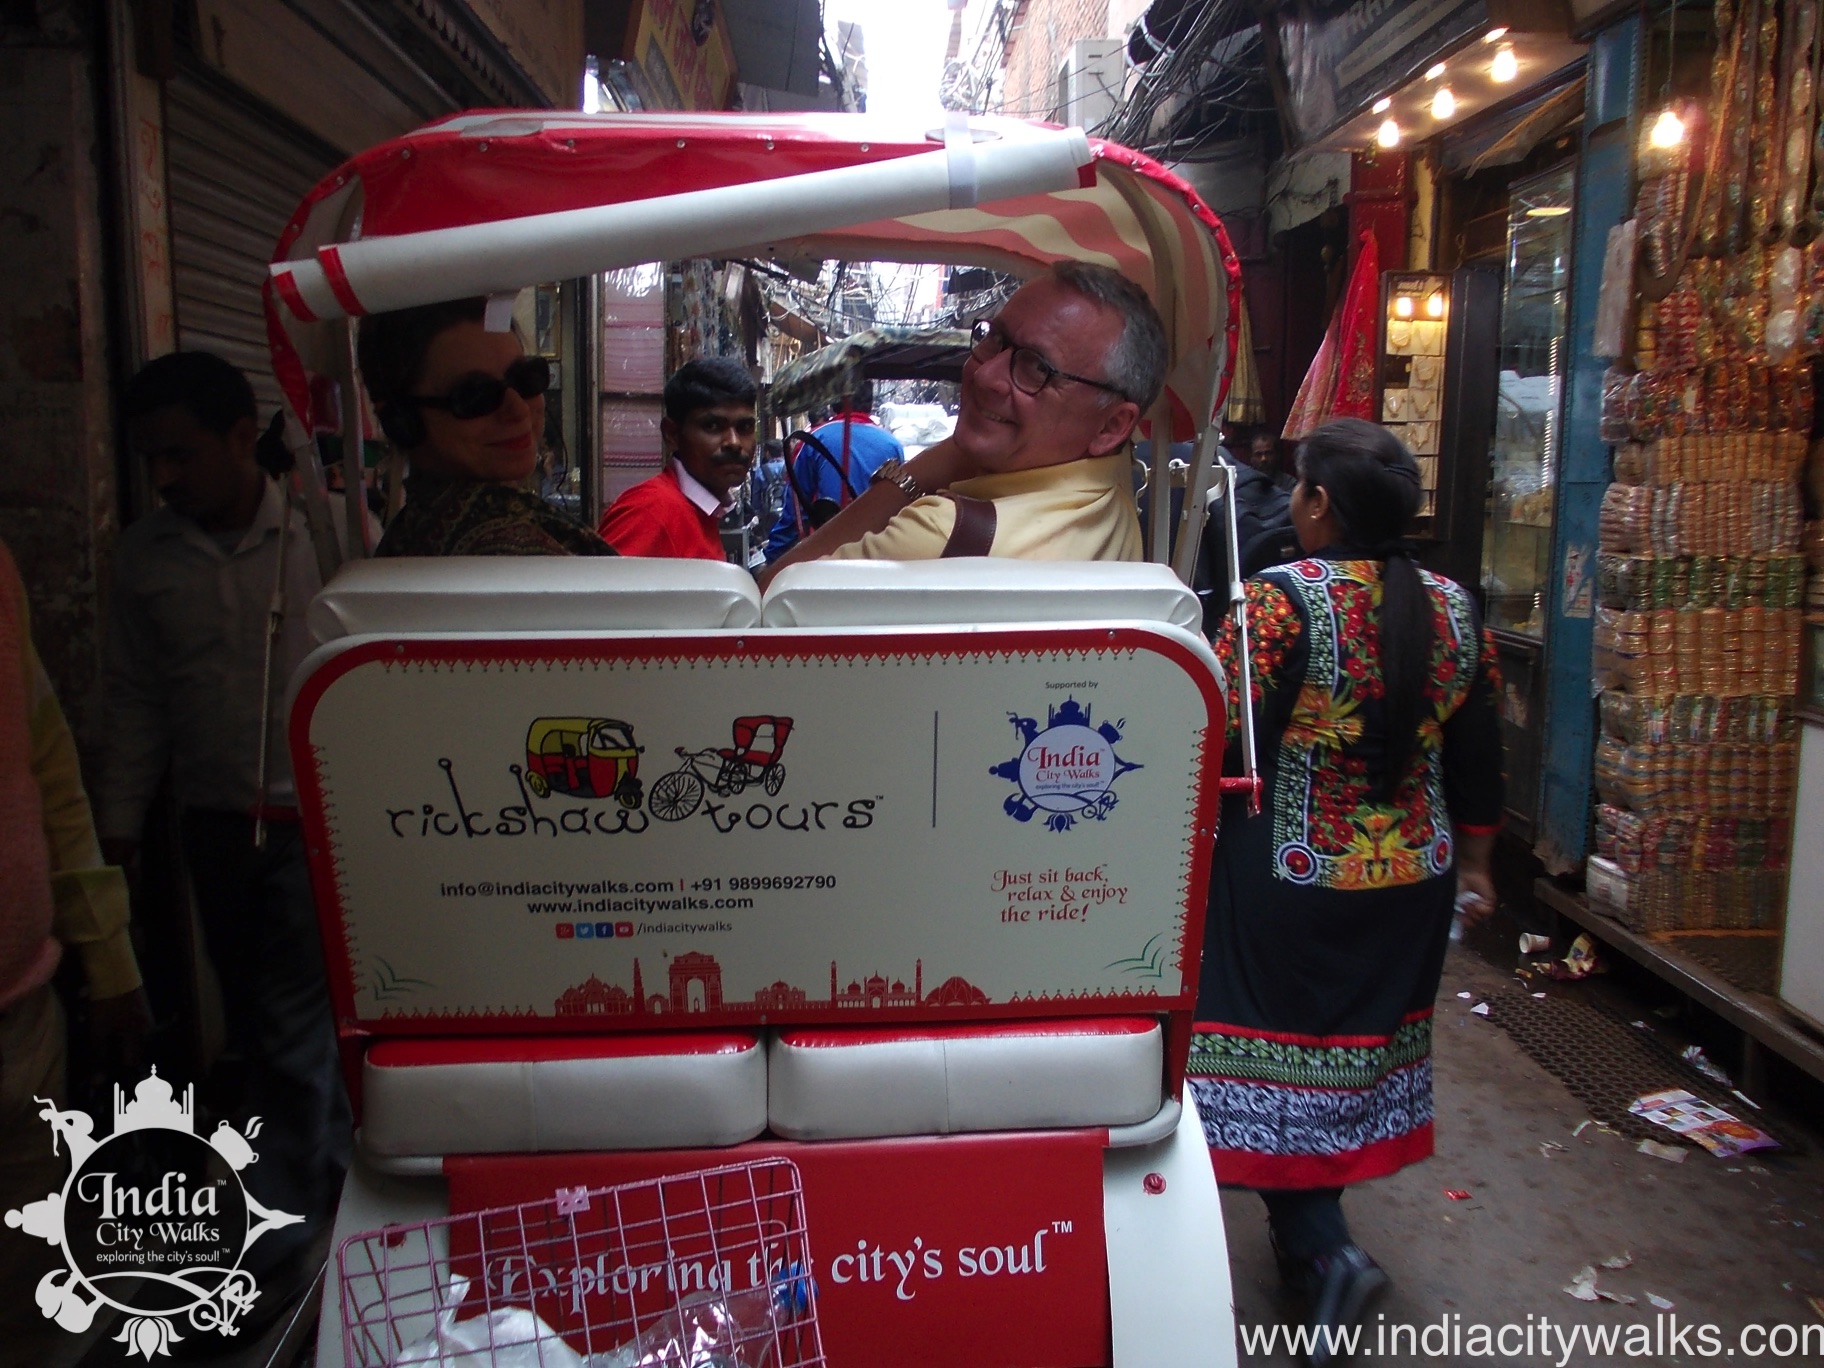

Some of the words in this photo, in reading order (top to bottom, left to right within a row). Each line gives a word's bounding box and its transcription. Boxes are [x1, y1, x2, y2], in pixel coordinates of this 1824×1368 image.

[1045, 681, 1087, 690] Supported
[1088, 680, 1099, 689] by
[1027, 745, 1100, 769] India
[1036, 769, 1061, 783] City
[1063, 769, 1100, 780] Walks
[385, 757, 650, 838] rickshaw
[701, 797, 876, 834] tours
[440, 879, 674, 898] info@indiacitywalks.com
[690, 877, 721, 892] +91
[728, 875, 837, 891] 9899692790
[990, 869, 1033, 892] Just
[1038, 868, 1059, 884] sit
[1064, 867, 1109, 883] back,
[1007, 887, 1053, 903] relax
[1060, 885, 1076, 903] &
[1081, 884, 1129, 905] enjoy
[526, 896, 754, 915] www.indiacitywalks.com
[1001, 905, 1031, 923] the
[1038, 903, 1090, 923] ride!
[637, 920, 733, 936] /indiacitywalks
[831, 1236, 943, 1301] city's
[958, 1229, 1048, 1277] soul
